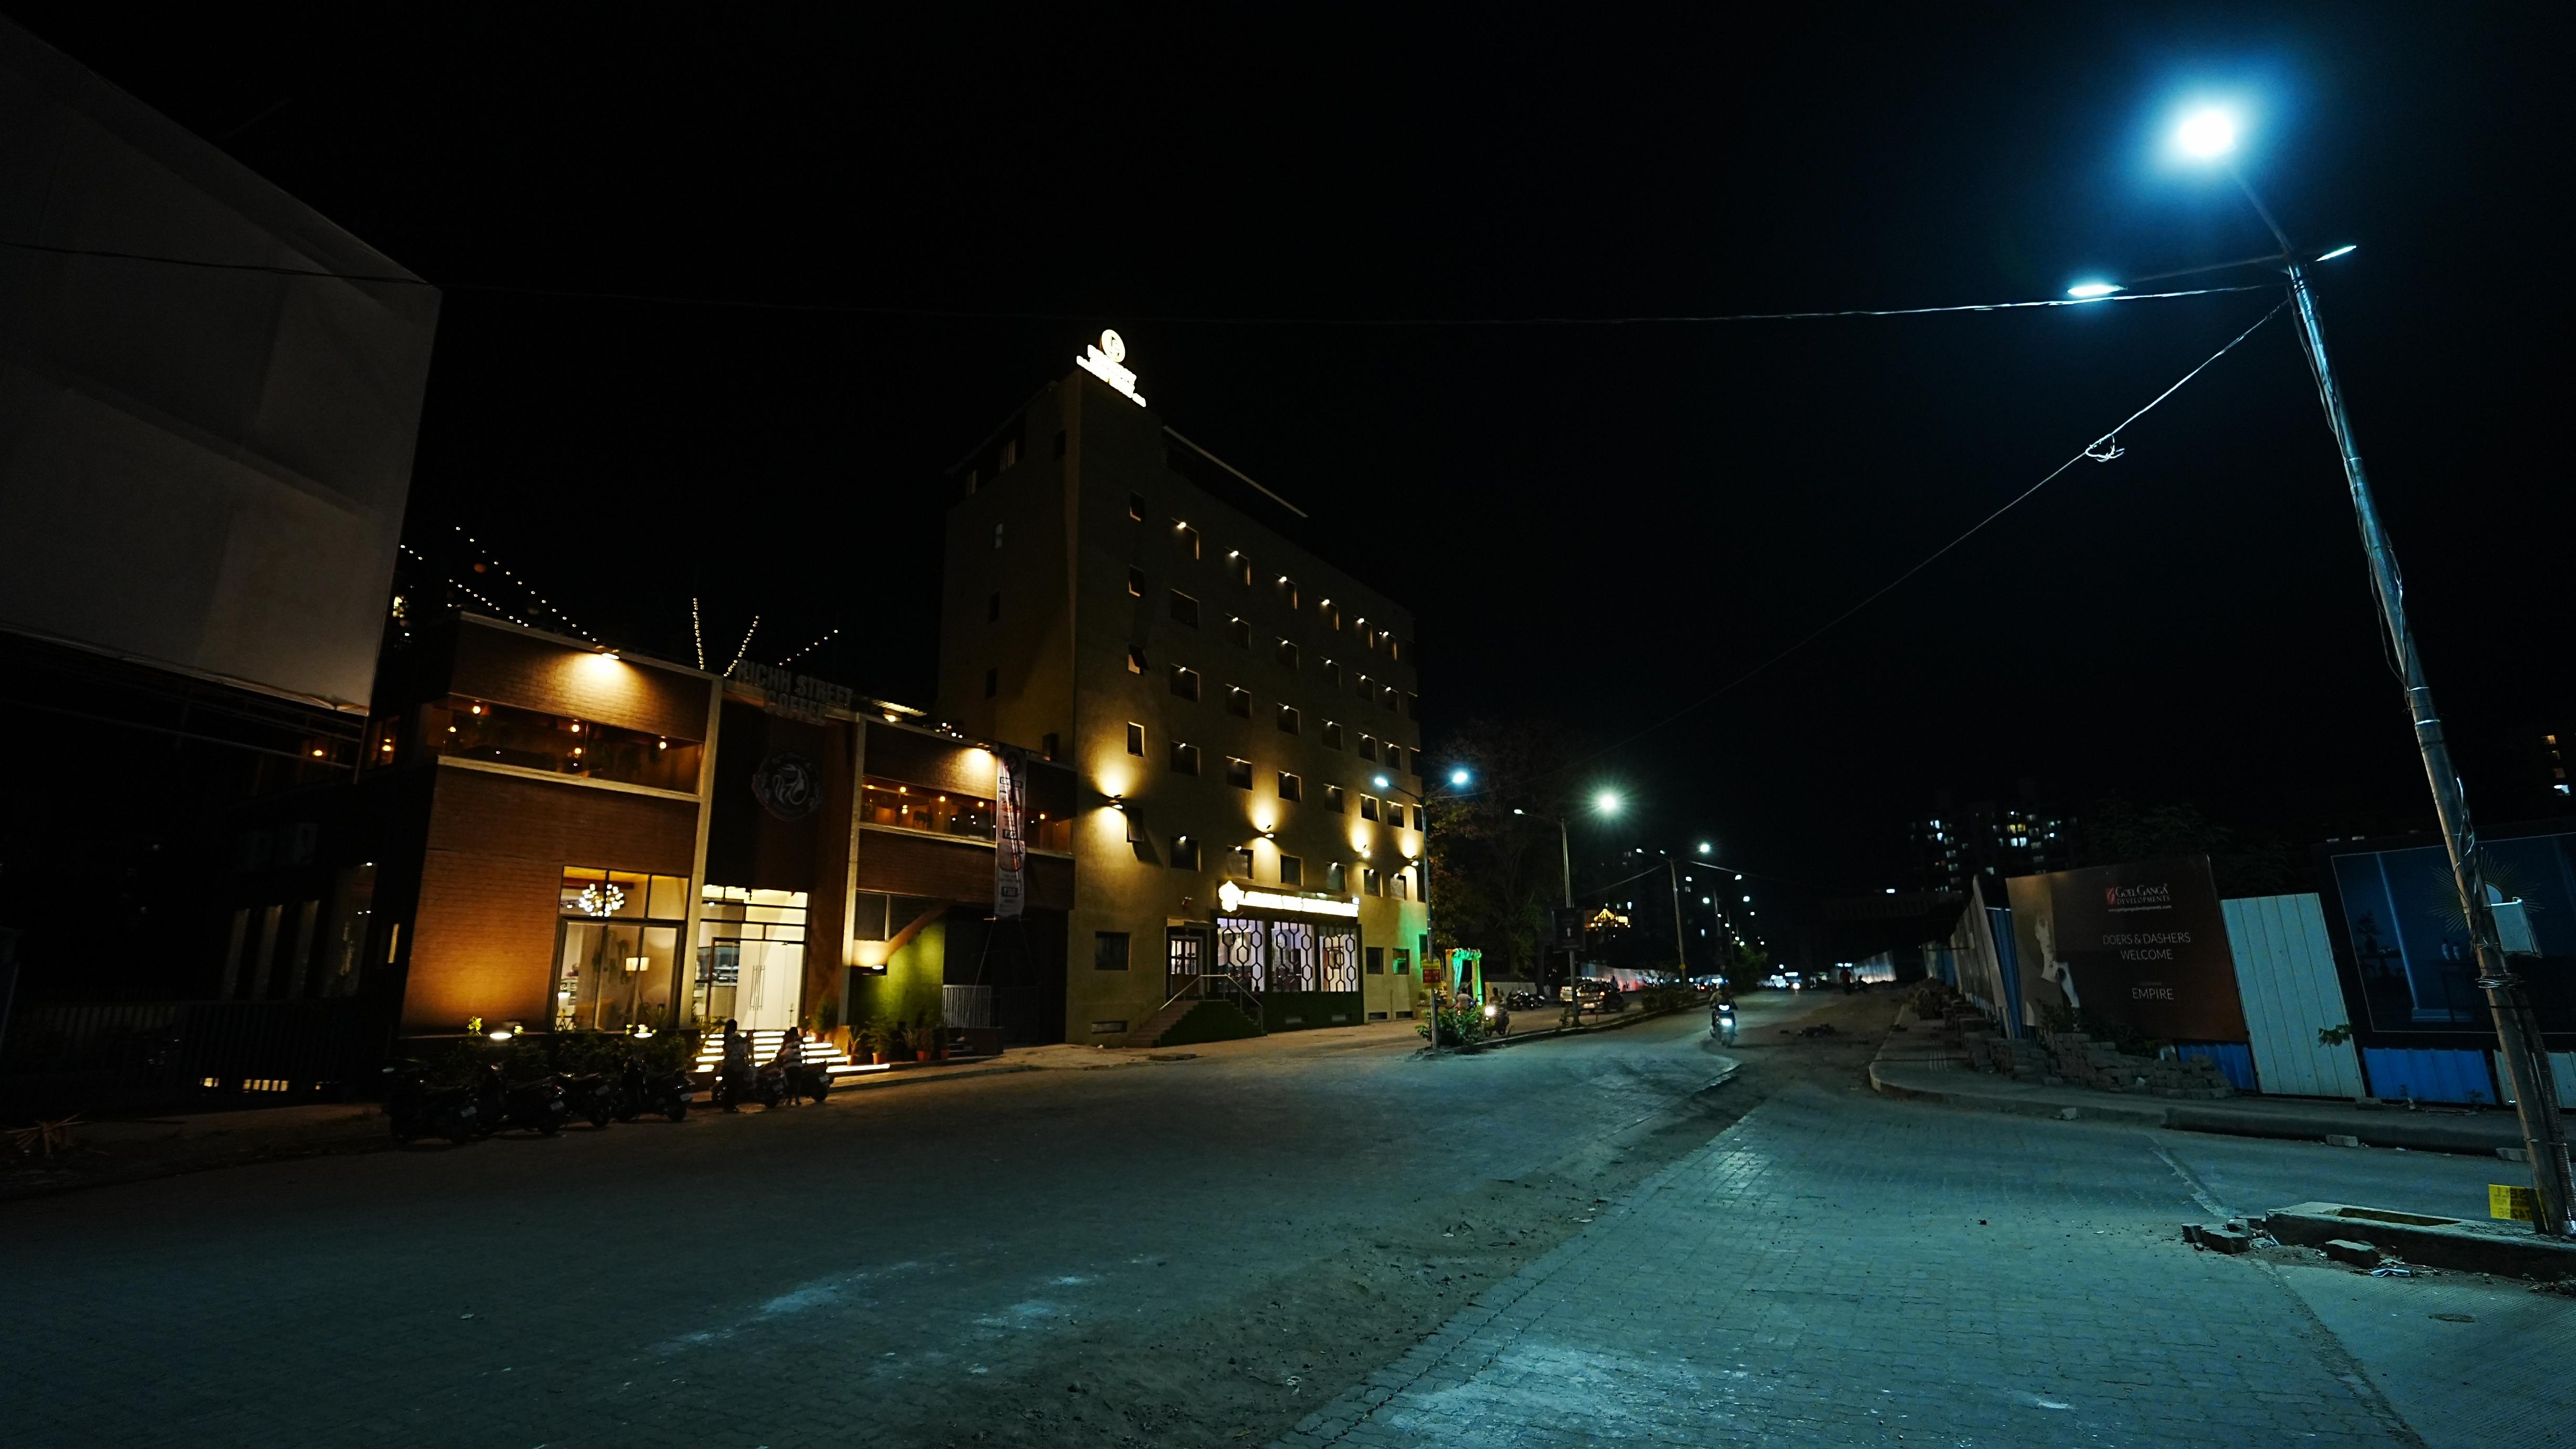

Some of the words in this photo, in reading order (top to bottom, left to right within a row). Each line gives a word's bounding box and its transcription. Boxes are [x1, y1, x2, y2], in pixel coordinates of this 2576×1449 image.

[794, 675, 853, 710] STREET
[2102, 934, 2132, 945] DOERS
[2134, 933, 2142, 944] &
[2143, 932, 2191, 944] DASHERS
[2120, 949, 2173, 960] WELCOME
[2131, 987, 2174, 1000] EMPIRE
